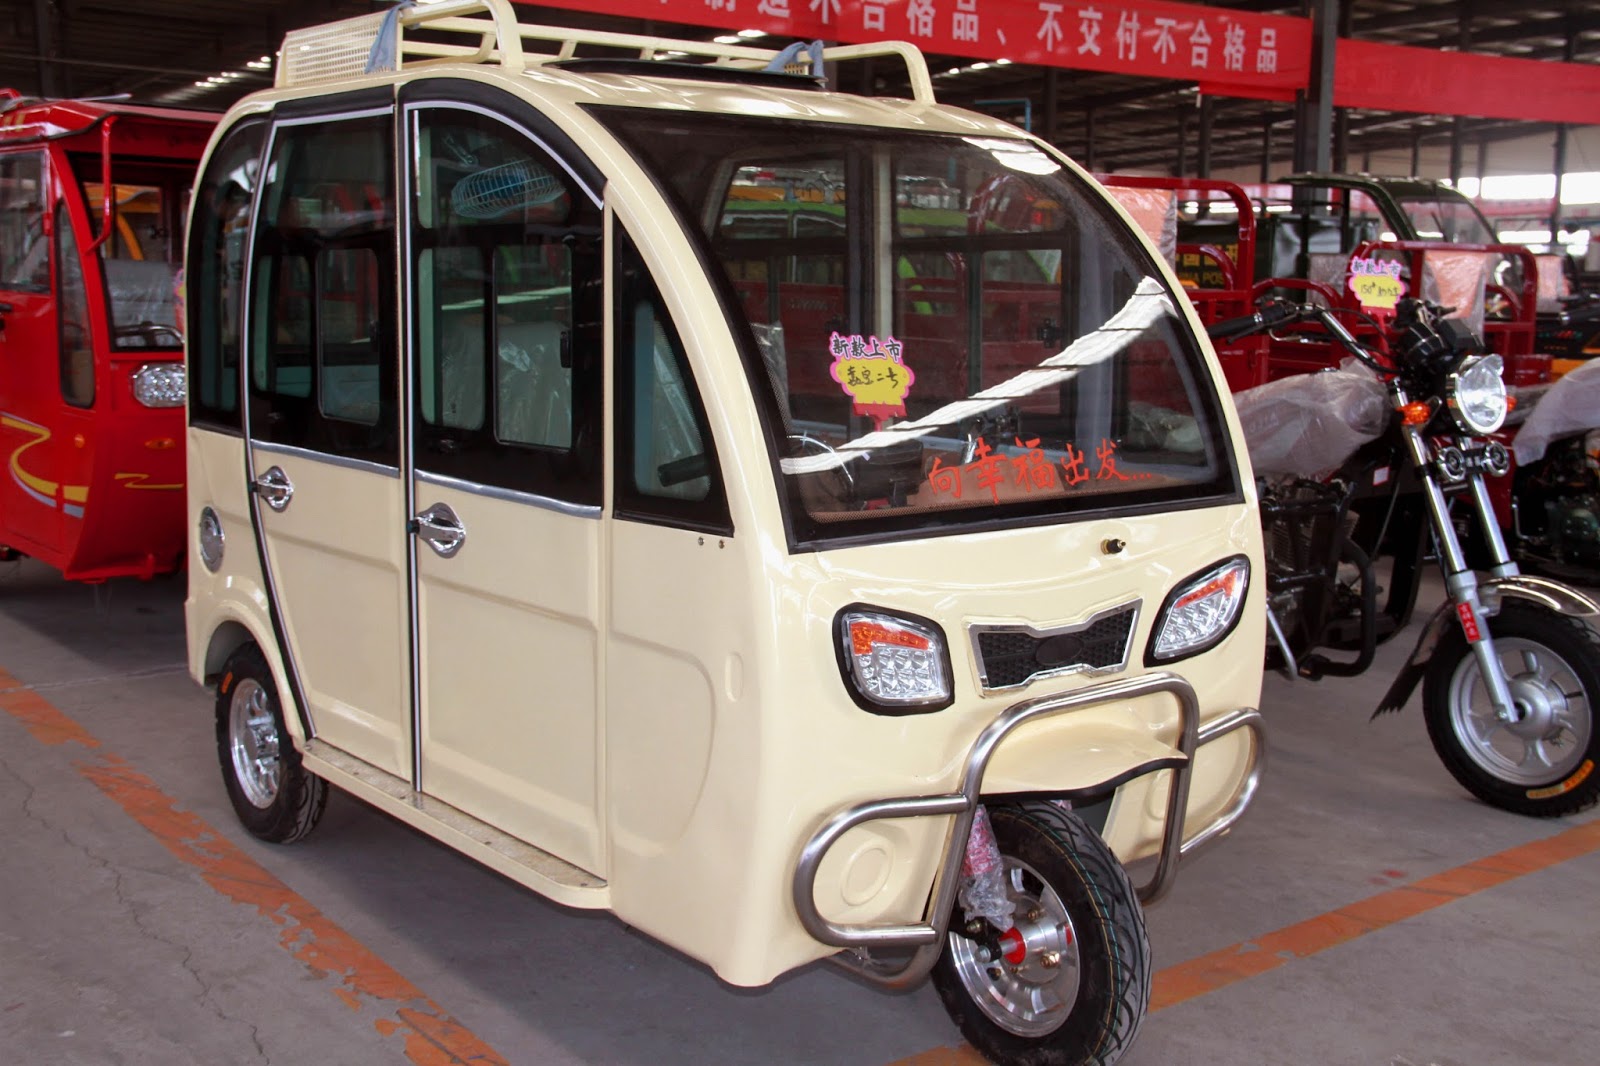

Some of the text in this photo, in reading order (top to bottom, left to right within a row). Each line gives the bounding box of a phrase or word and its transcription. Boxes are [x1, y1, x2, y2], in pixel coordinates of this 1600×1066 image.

[661, 0, 1277, 74] 合格品、不交付不合格品
[1202, 271, 1227, 285] POS
[1353, 257, 1400, 277] 新款上市
[831, 334, 902, 362] 新款上市
